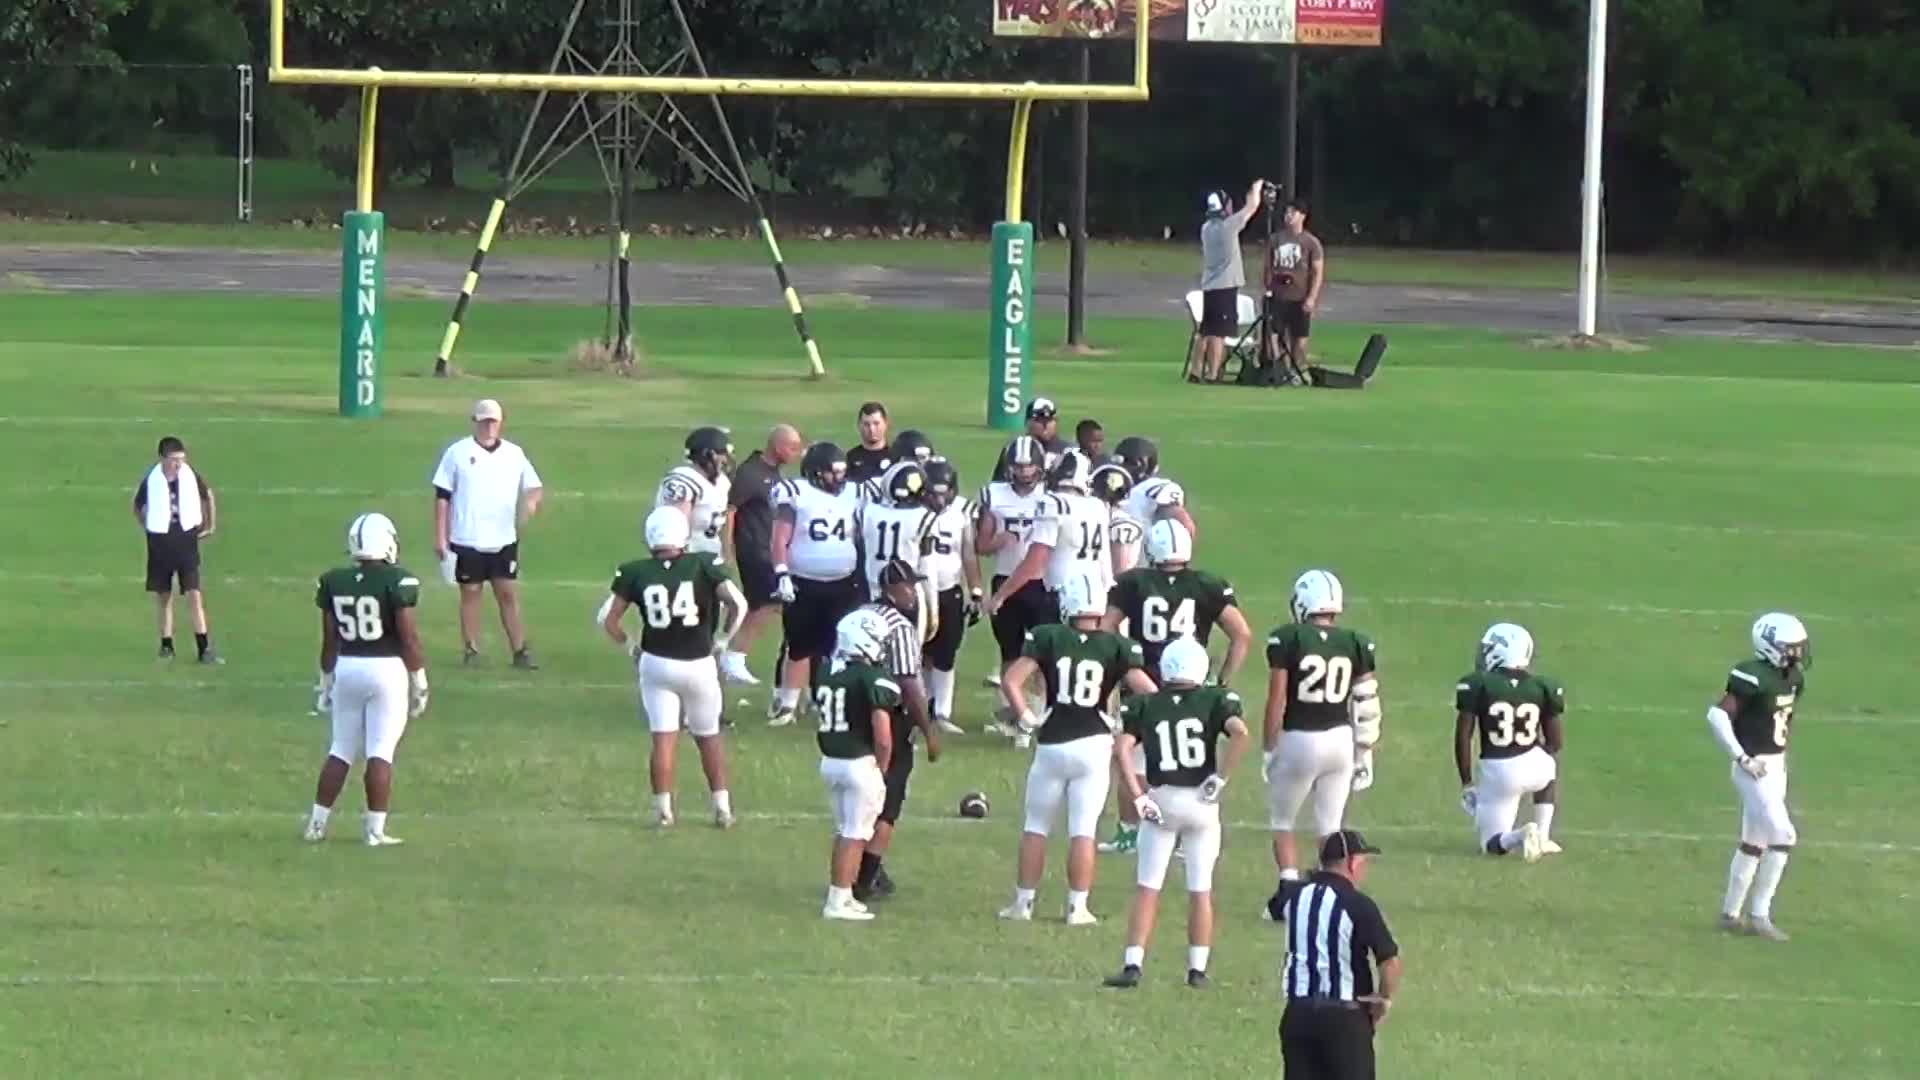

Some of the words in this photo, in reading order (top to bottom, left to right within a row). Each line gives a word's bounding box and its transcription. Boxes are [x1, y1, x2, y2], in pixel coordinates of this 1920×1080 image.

[357, 228, 378, 406] MENARD
[1003, 238, 1025, 414] EAGLES
[809, 517, 847, 541] 64
[875, 520, 901, 561] 11
[1076, 520, 1103, 561] 14
[1114, 526, 1133, 544] 17
[333, 595, 383, 641] 58
[643, 581, 699, 628] 84
[1142, 596, 1197, 642] 64
[1056, 655, 1104, 707] 18
[1297, 654, 1352, 704] 20
[816, 685, 849, 732] 31
[1488, 701, 1540, 747] 33
[1155, 717, 1206, 771] 16
